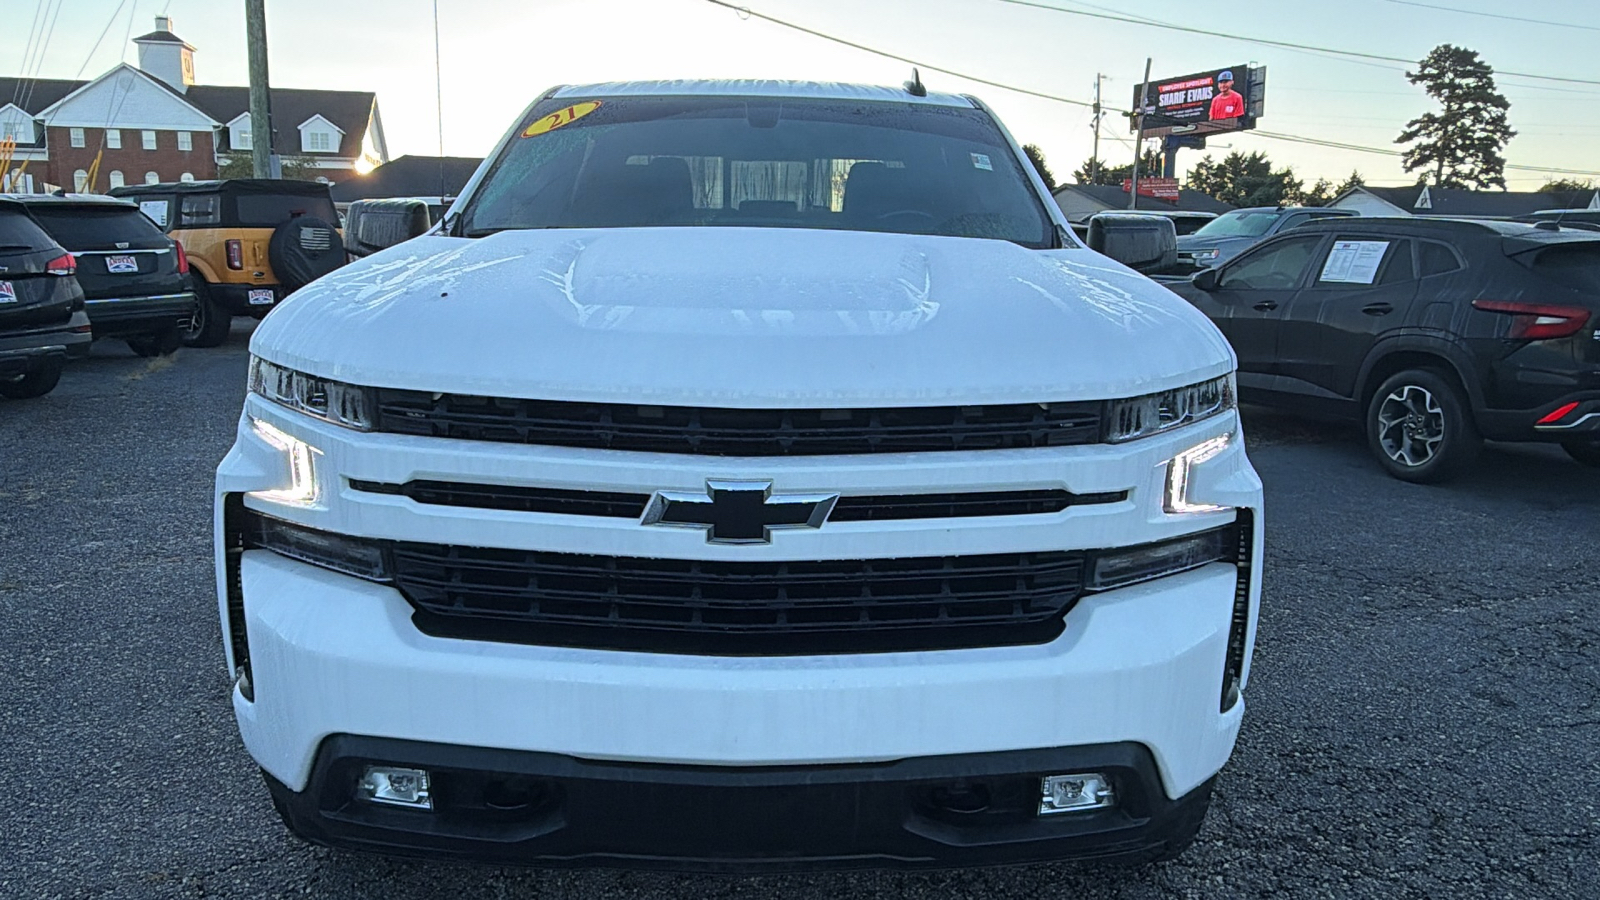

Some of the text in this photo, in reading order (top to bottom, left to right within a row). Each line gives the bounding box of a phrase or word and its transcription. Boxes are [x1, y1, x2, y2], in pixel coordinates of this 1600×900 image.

[1159, 90, 1186, 107] SHARIF
[1187, 86, 1213, 103] EVANS
[547, 106, 576, 129] 21
